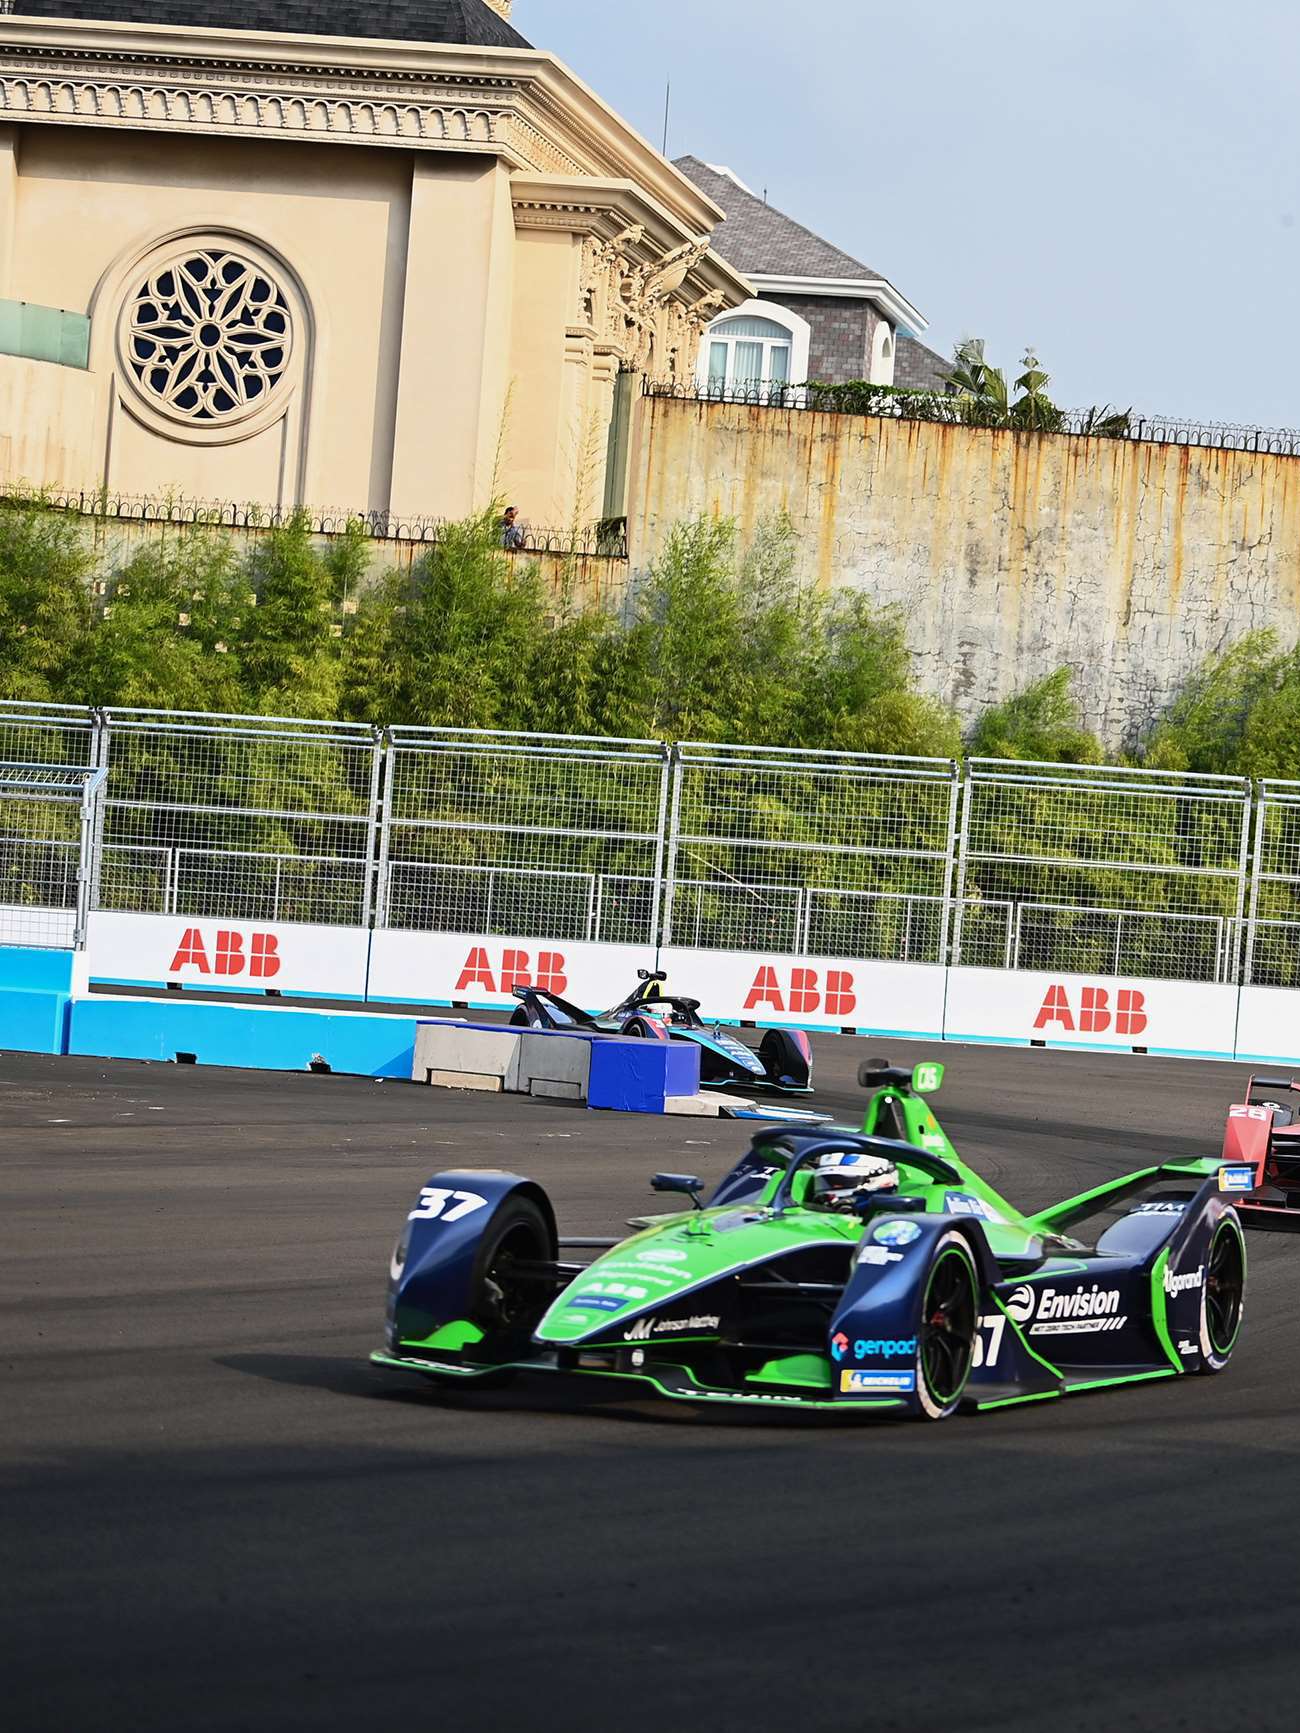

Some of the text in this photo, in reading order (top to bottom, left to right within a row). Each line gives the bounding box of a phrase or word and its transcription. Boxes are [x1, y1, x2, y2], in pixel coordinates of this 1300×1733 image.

[170, 927, 281, 977] ABB
[455, 947, 568, 995] ABB
[743, 965, 857, 1015] ABB
[1034, 985, 1148, 1035] ABB
[407, 1187, 489, 1222] 37
[1036, 1284, 1121, 1320] Envision
